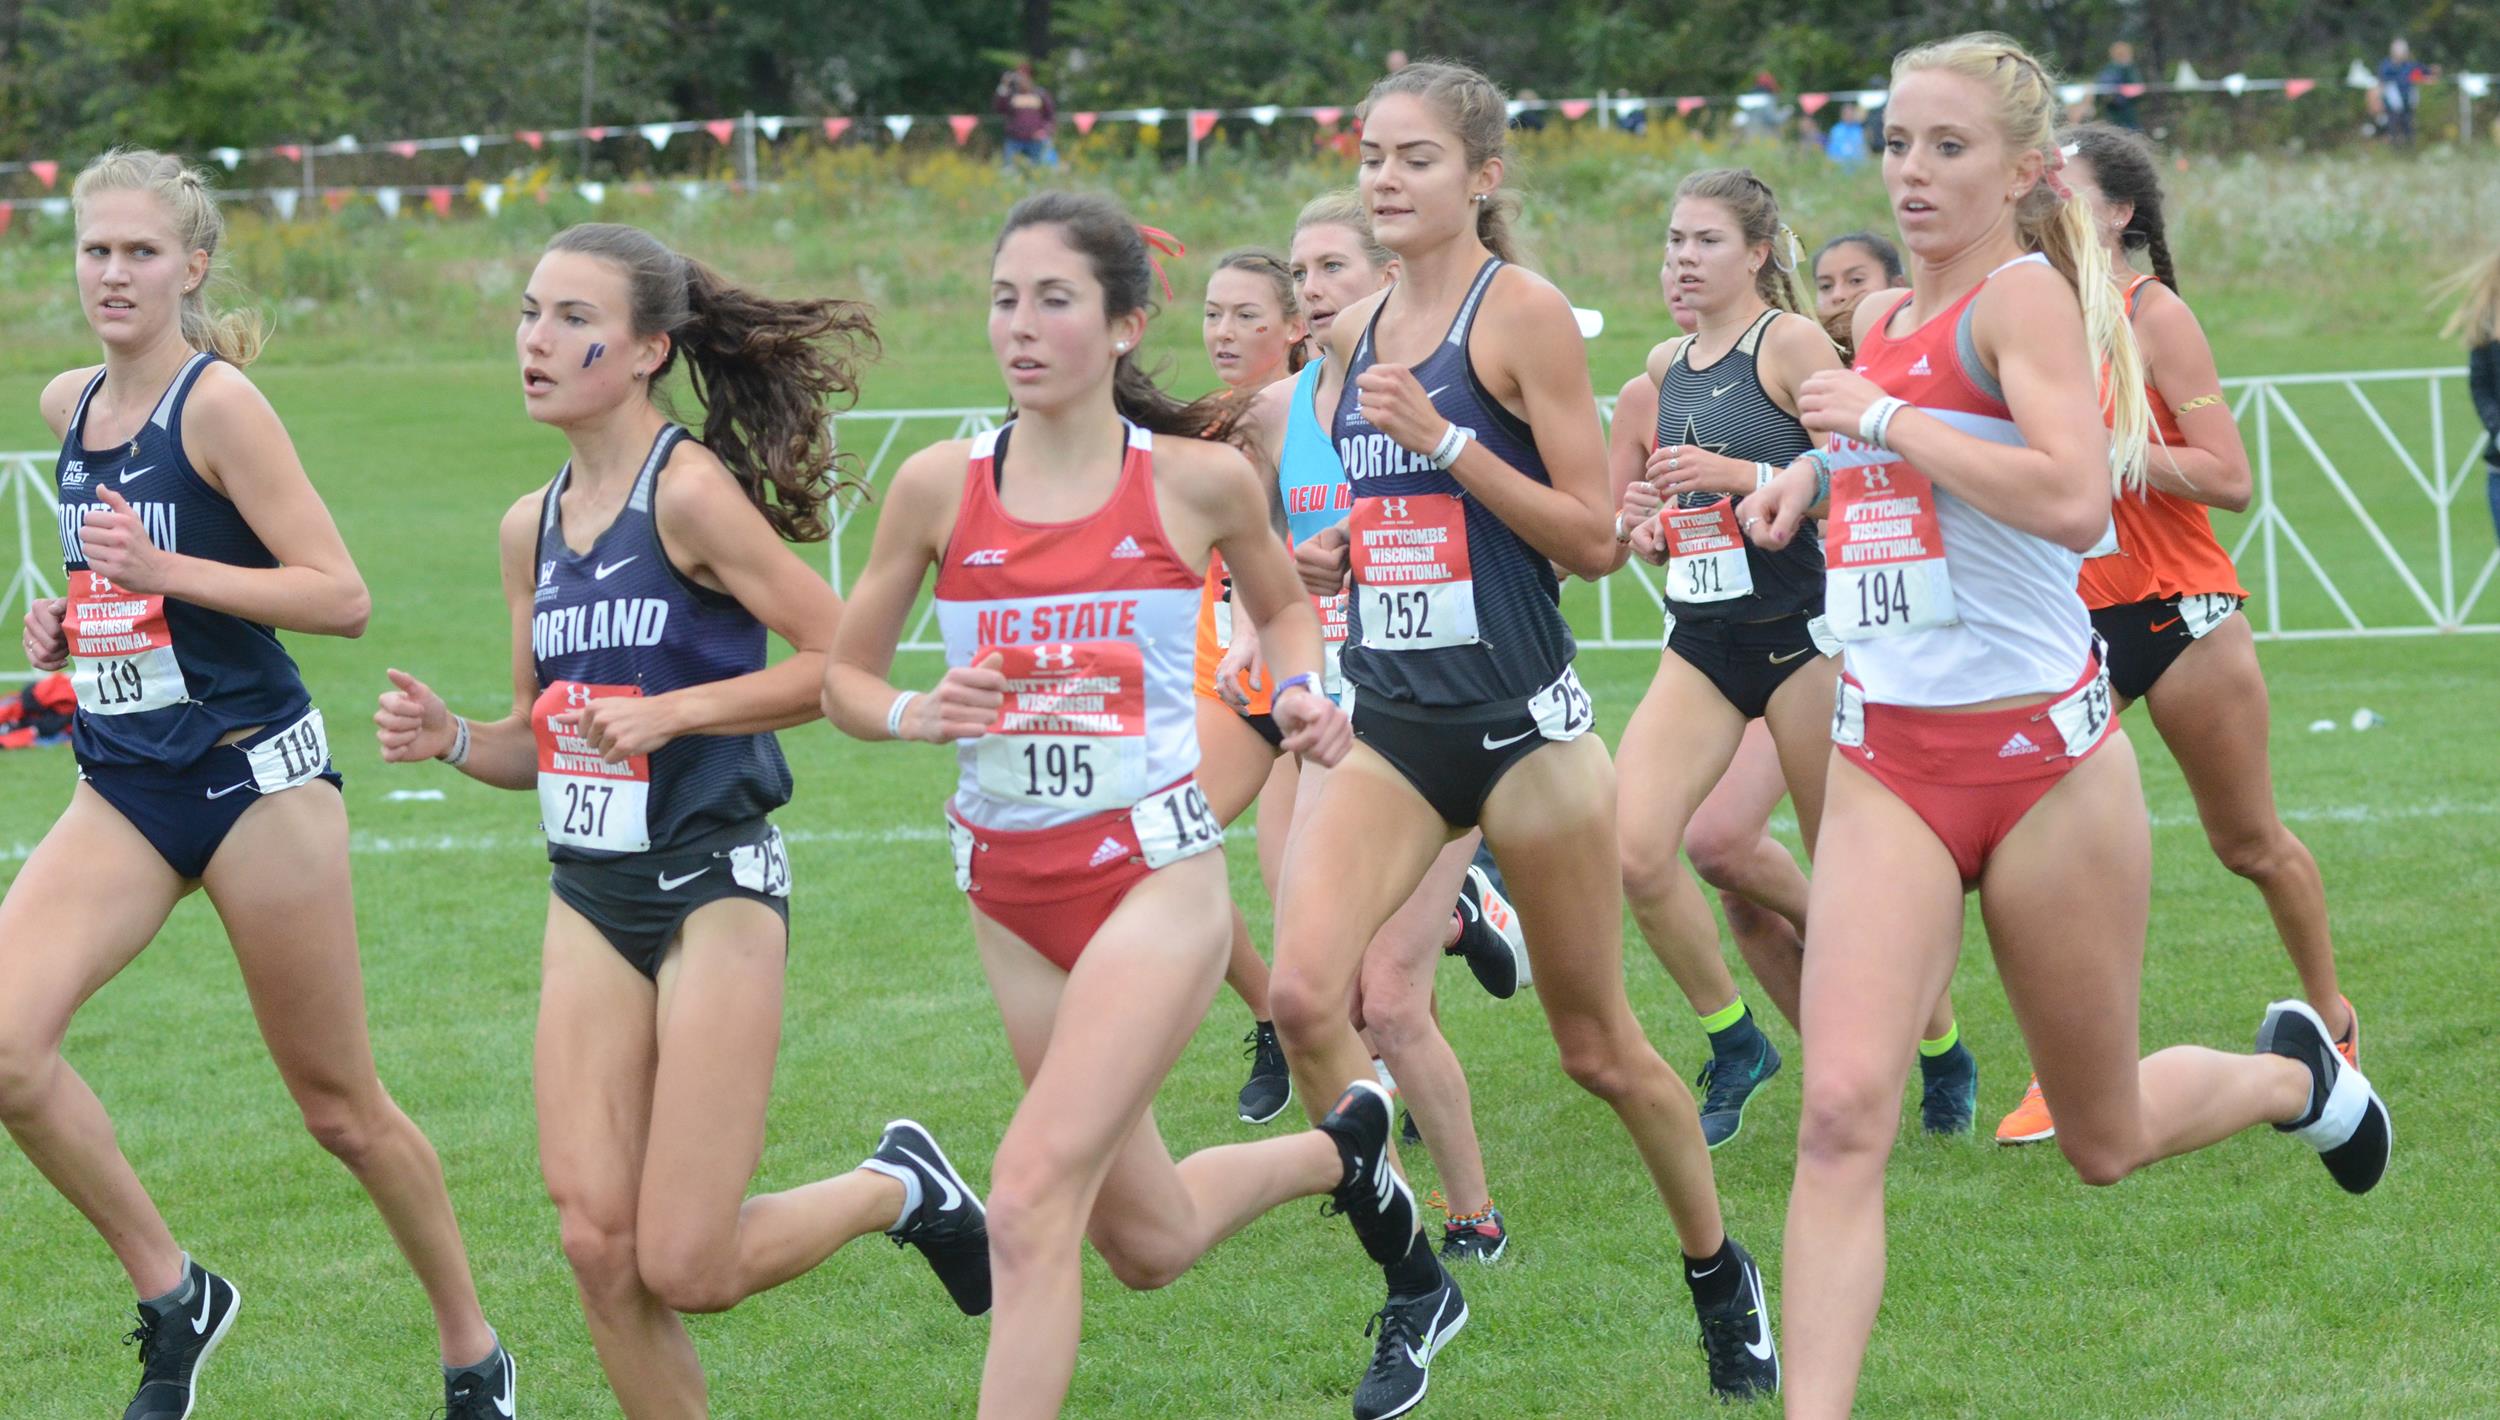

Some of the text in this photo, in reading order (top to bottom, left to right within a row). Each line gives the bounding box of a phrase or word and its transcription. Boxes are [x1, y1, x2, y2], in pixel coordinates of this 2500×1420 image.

[1289, 484, 1328, 516] NEW
[1363, 527, 1448, 546] NUTTYCOMBE
[1850, 518, 1913, 541] WISCONSIN
[963, 549, 1008, 566] ACC
[1369, 546, 1435, 563] WISCONSIN
[1841, 538, 1927, 563] INVITATIONAL
[1364, 563, 1452, 582] INVITATIONAL
[1688, 556, 1722, 595] 371
[1857, 569, 1910, 627] 194
[977, 600, 1138, 646] NC STATE
[1380, 591, 1432, 639] 252
[97, 659, 143, 704] 119
[1016, 694, 1105, 712] WISCONSIN
[1552, 670, 1589, 733] 25
[1002, 711, 1124, 733] INVITATIONAL
[274, 720, 321, 783] 119
[1999, 745, 2040, 758] adidas
[1024, 743, 1094, 797] 195
[564, 782, 614, 837] 257
